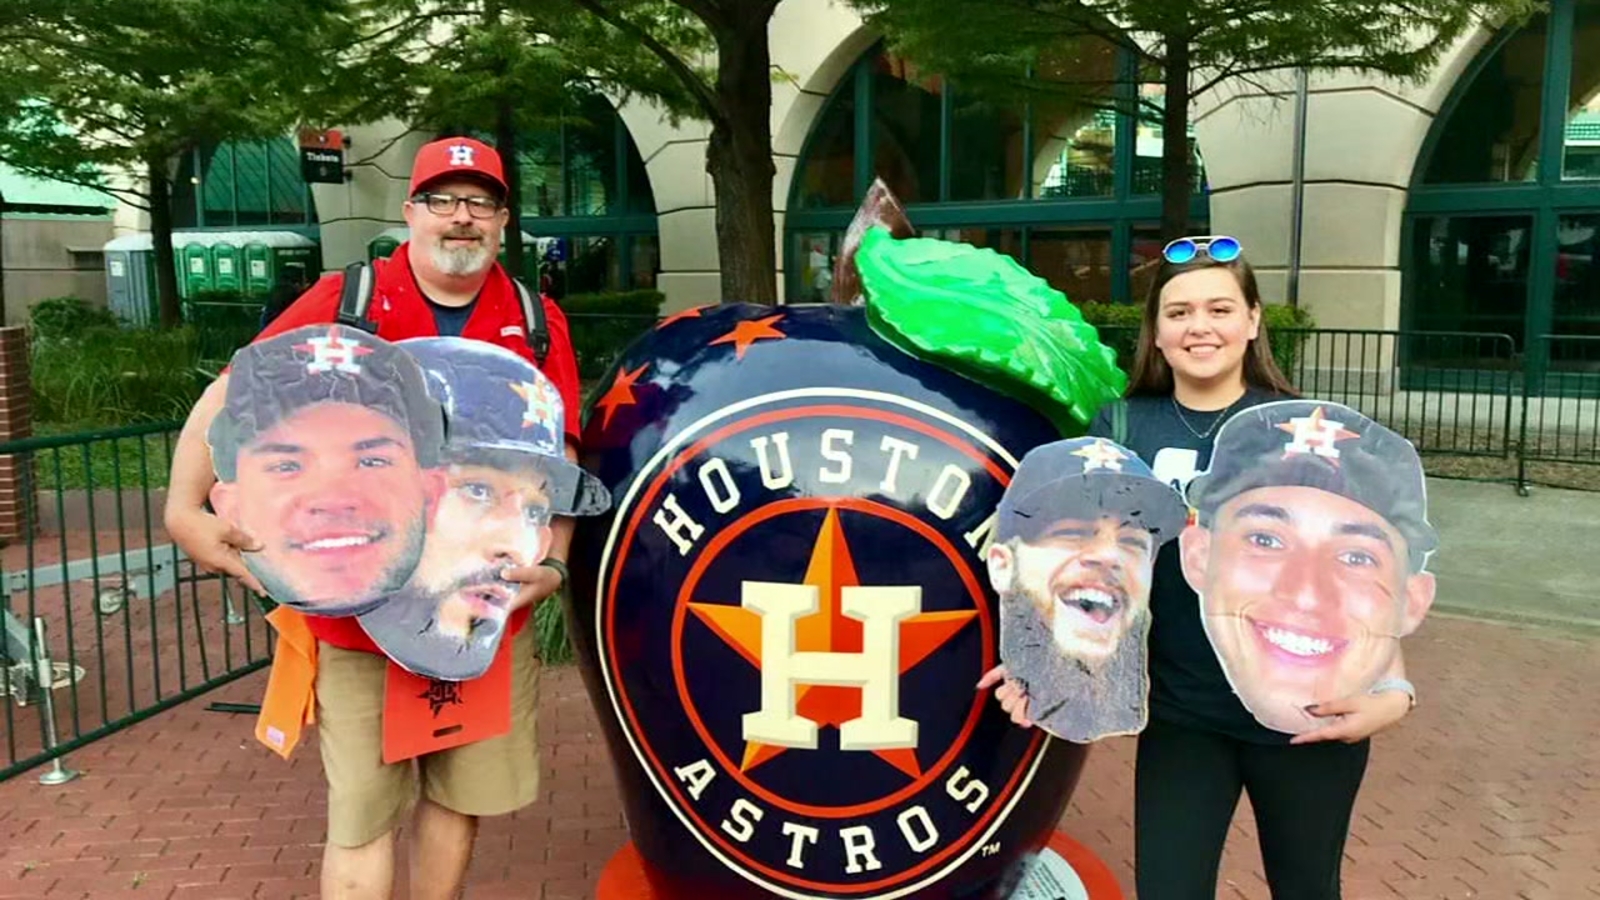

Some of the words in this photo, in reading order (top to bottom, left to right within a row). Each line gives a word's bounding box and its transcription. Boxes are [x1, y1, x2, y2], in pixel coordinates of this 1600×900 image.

[449, 145, 475, 167] H
[306, 336, 361, 375] H
[1285, 416, 1345, 458] H
[741, 580, 922, 750] H
[674, 758, 989, 874] ASTROS
[981, 841, 1001, 857] TM
